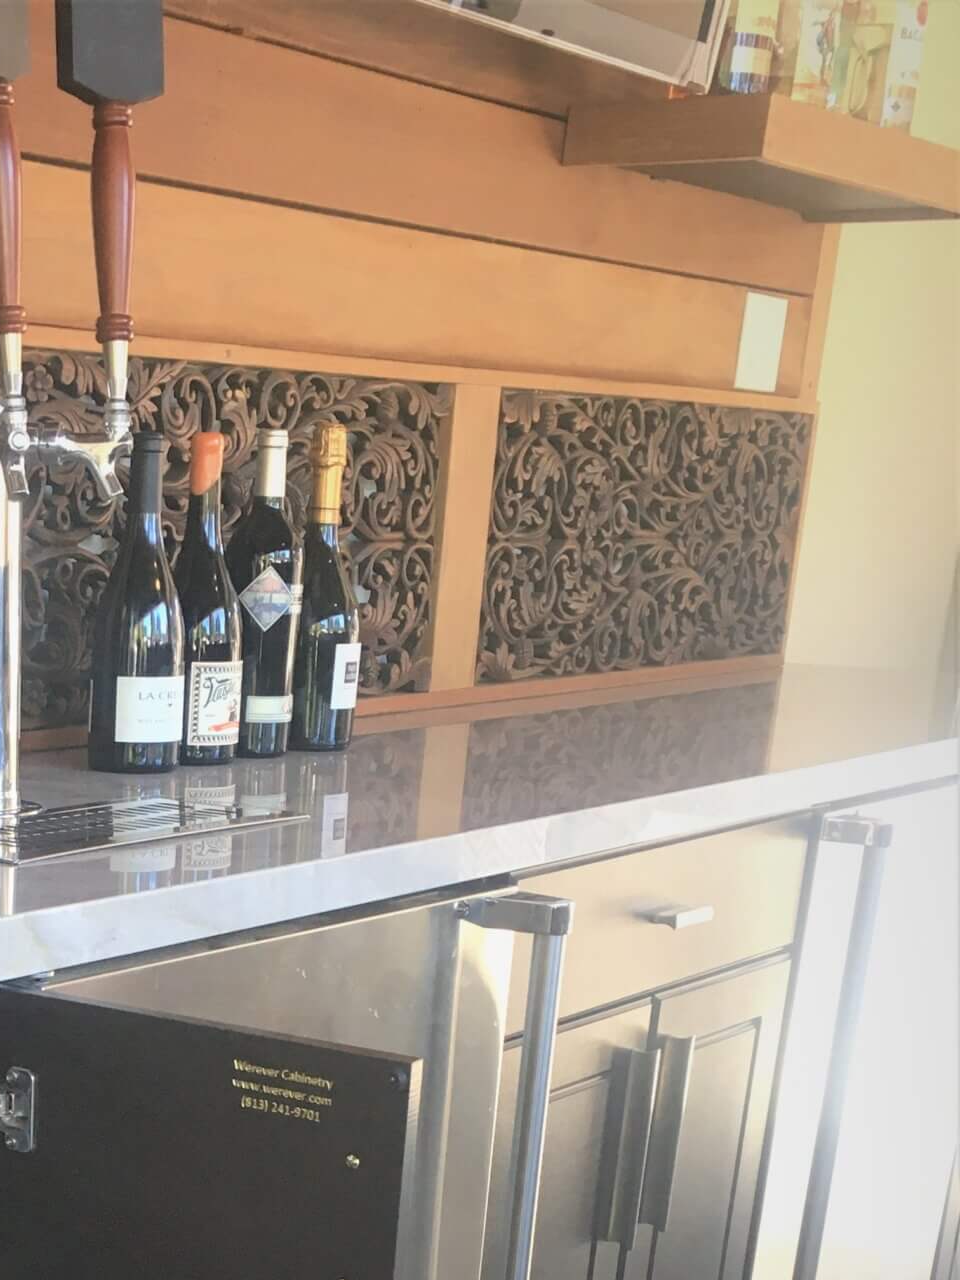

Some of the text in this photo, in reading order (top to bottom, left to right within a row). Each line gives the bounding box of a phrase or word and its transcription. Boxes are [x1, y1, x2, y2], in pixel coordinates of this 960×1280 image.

[233, 1059, 333, 1091] Werever Cabinetry
[232, 1079, 332, 1106] www.werever.com
[271, 1102, 320, 1122] 241-9701
